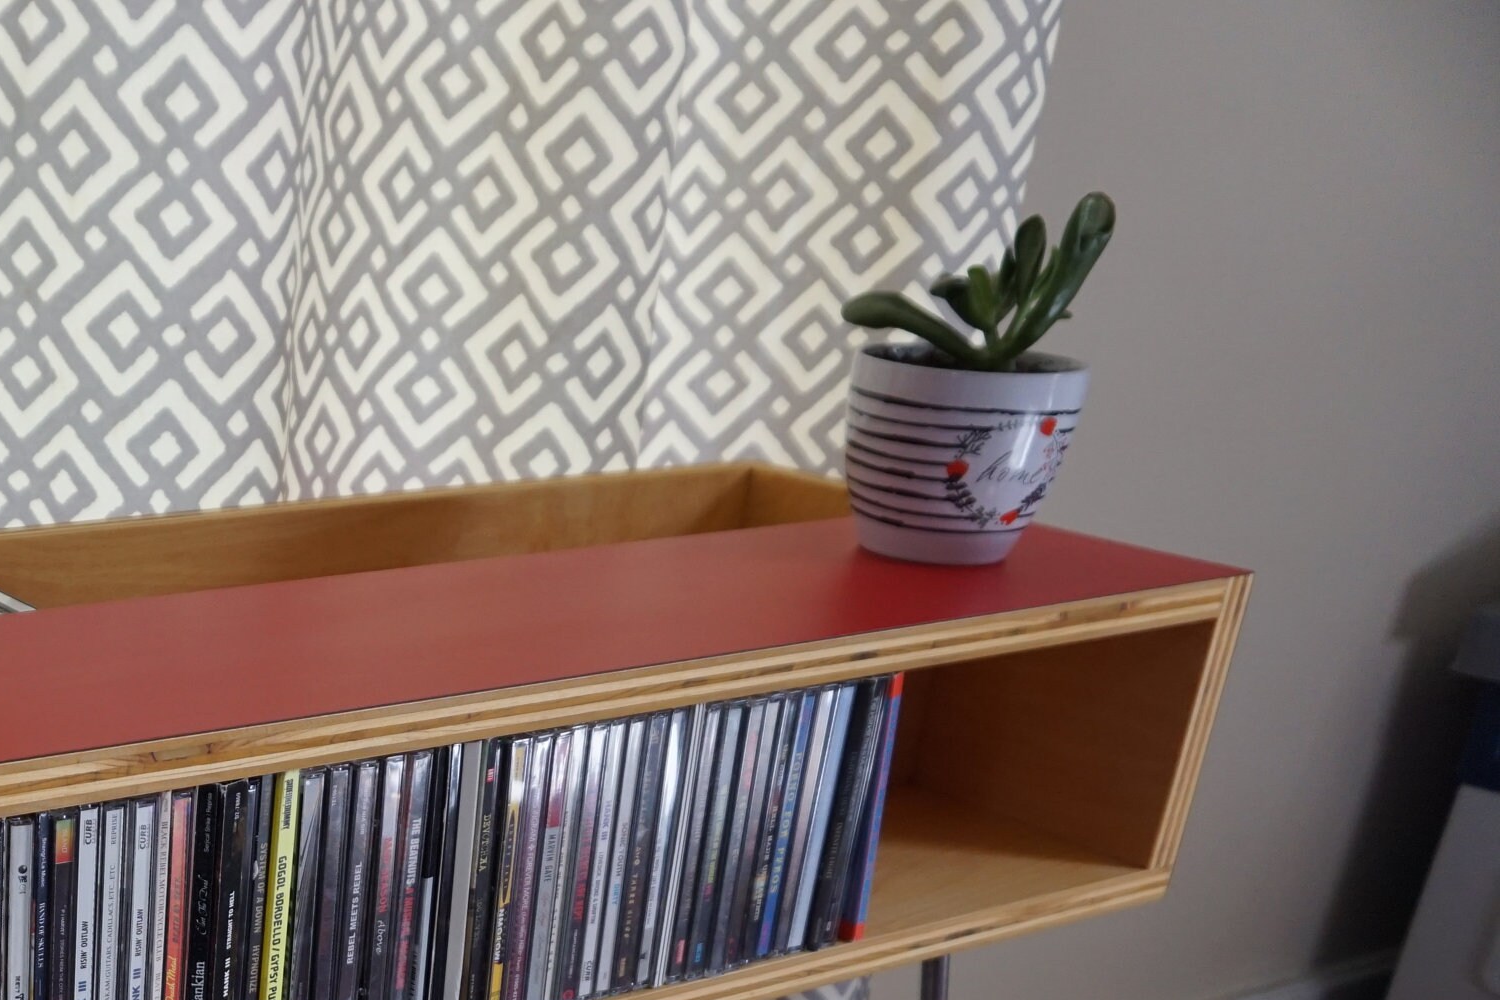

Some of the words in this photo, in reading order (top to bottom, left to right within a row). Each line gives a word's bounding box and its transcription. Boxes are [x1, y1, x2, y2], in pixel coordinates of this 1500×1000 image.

[974, 450, 1044, 484] home
[787, 751, 805, 802] PORNO
[205, 792, 213, 813] Reprise
[602, 800, 613, 829] HANK
[84, 819, 93, 845] CURB
[110, 814, 118, 845] REPRISE
[139, 824, 147, 850] CURB
[159, 820, 169, 849] BLACK
[411, 818, 422, 835] THE
[528, 810, 540, 841] INGRAM
[600, 831, 609, 841] III
[619, 822, 630, 848] SONIC
[778, 810, 794, 839] FOR
[40, 837, 48, 869] Shangri-La
[203, 833, 211, 853] Serjical
[478, 814, 492, 872] DEVOTCHKA
[546, 834, 557, 862] MARVIN
[158, 850, 168, 877] REBEL
[258, 842, 269, 880] SYSTEM
[276, 855, 288, 890] GOGOL
[524, 852, 534, 886] FOREVER
[543, 865, 554, 883] GAYE
[616, 850, 626, 877] YOUTH
[770, 847, 785, 894] PYROS
[257, 882, 267, 894] OF
[352, 861, 363, 894] REBEL
[378, 869, 391, 913] SEASON
[592, 879, 601, 898] BROKE
[256, 896, 265, 904] A
[521, 887, 530, 911] MORE
[612, 883, 620, 905] DIRTY
[38, 902, 46, 924] BAND
[135, 908, 144, 936] OUTLAW
[156, 879, 166, 939] MOTORCYCLE
[227, 909, 234, 918] TO
[254, 905, 264, 933] DOWN
[272, 892, 285, 945] BORDELLO
[350, 896, 360, 930] MEETS
[38, 926, 45, 936] OF
[80, 920, 89, 948] OUTLAW
[225, 919, 234, 950] STRAIGHT
[374, 920, 387, 956] Above
[493, 908, 505, 961] MOTOWN
[37, 938, 45, 968] SKULLS
[58, 939, 66, 958] STORIES
[80, 950, 88, 970] RISIN'
[134, 937, 142, 957] RISIN'
[346, 932, 356, 964] REBEL
[132, 968, 142, 980] III
[166, 955, 177, 981] Metal
[223, 957, 231, 968] III
[248, 944, 260, 994] HYPNOTIZE
[270, 954, 280, 984] GYPSY
[584, 960, 592, 982] CURB
[78, 980, 87, 992] III
[222, 969, 230, 998] HANK
